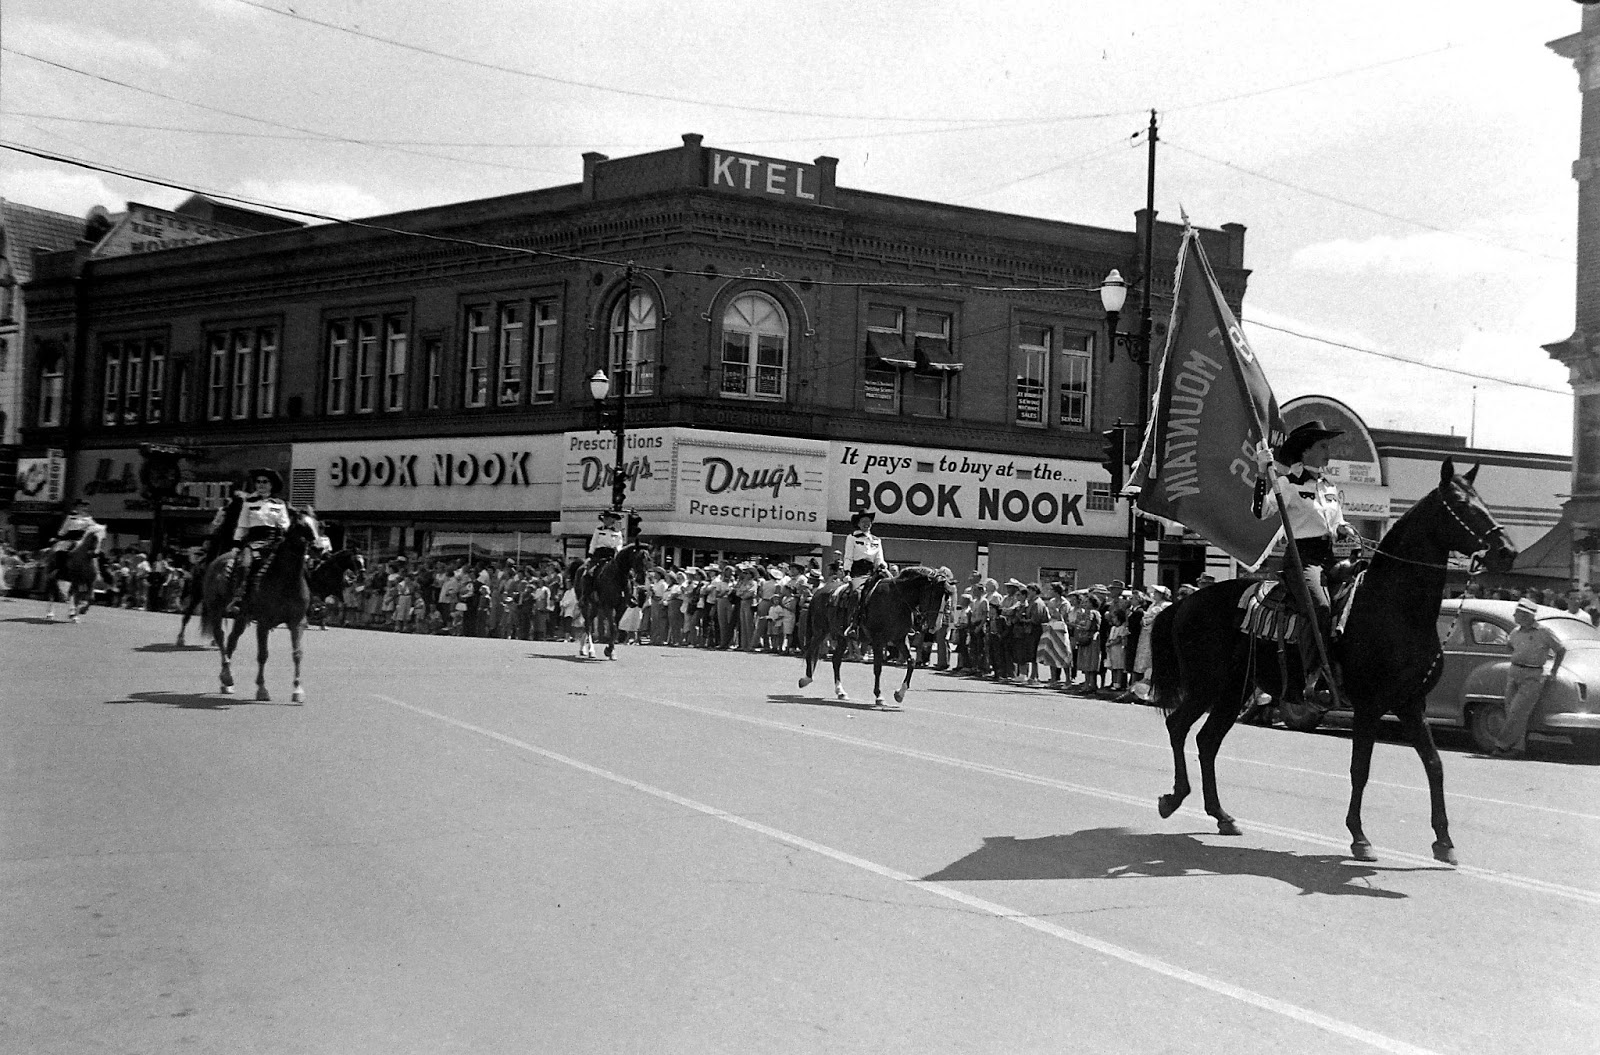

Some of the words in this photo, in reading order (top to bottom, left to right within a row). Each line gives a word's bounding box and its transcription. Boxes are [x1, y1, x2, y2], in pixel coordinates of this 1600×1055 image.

[713, 153, 815, 200] KTEL
[570, 433, 663, 451] Prescritions
[329, 455, 418, 487] BOOK
[432, 450, 531, 487] NOOK
[580, 455, 653, 493] Drgs
[702, 457, 802, 499] Drugs
[840, 446, 859, 465] It
[862, 454, 913, 475] pays
[939, 454, 957, 472] to
[959, 457, 993, 482] buy
[995, 460, 1015, 477] at
[689, 499, 818, 522] Prescriptions
[848, 478, 963, 519] BOOK
[978, 487, 1084, 527] NOOK
